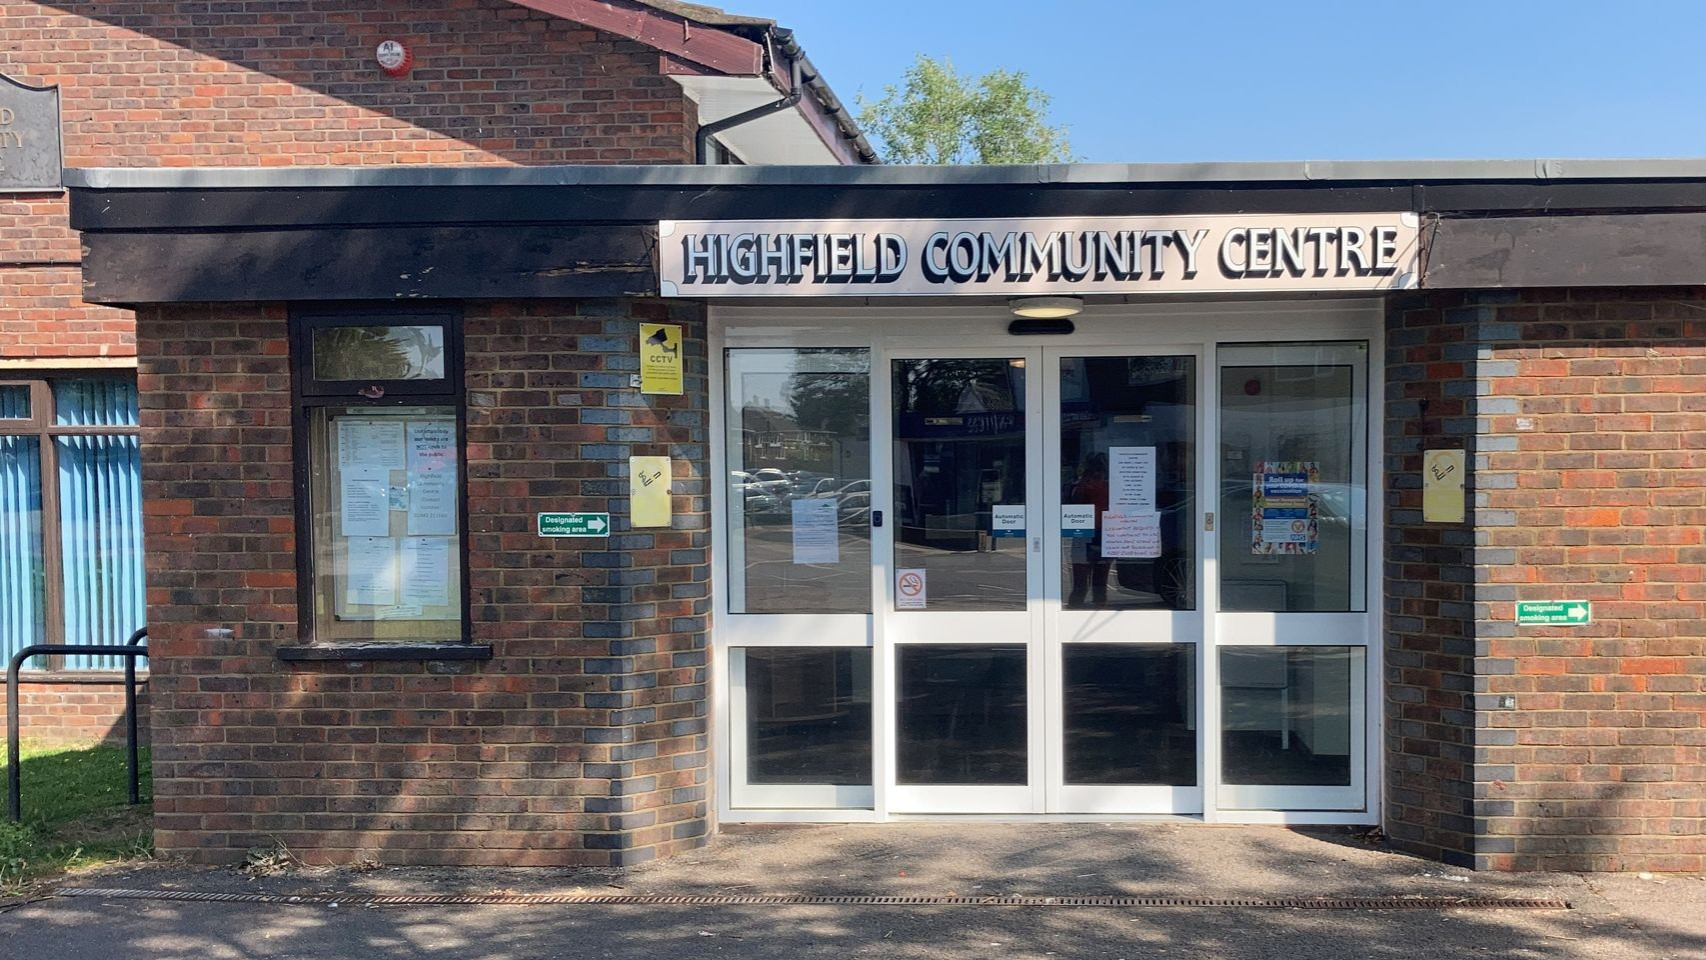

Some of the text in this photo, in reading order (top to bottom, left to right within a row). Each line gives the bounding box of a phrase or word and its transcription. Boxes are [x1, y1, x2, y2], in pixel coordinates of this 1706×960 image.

[681, 226, 1399, 285] HIGHFIELD COMMUNITY CENTRE
[650, 355, 673, 364] CCTV
[545, 516, 584, 525] Designated
[542, 526, 571, 534] smoking
[1520, 614, 1550, 622] smoking
